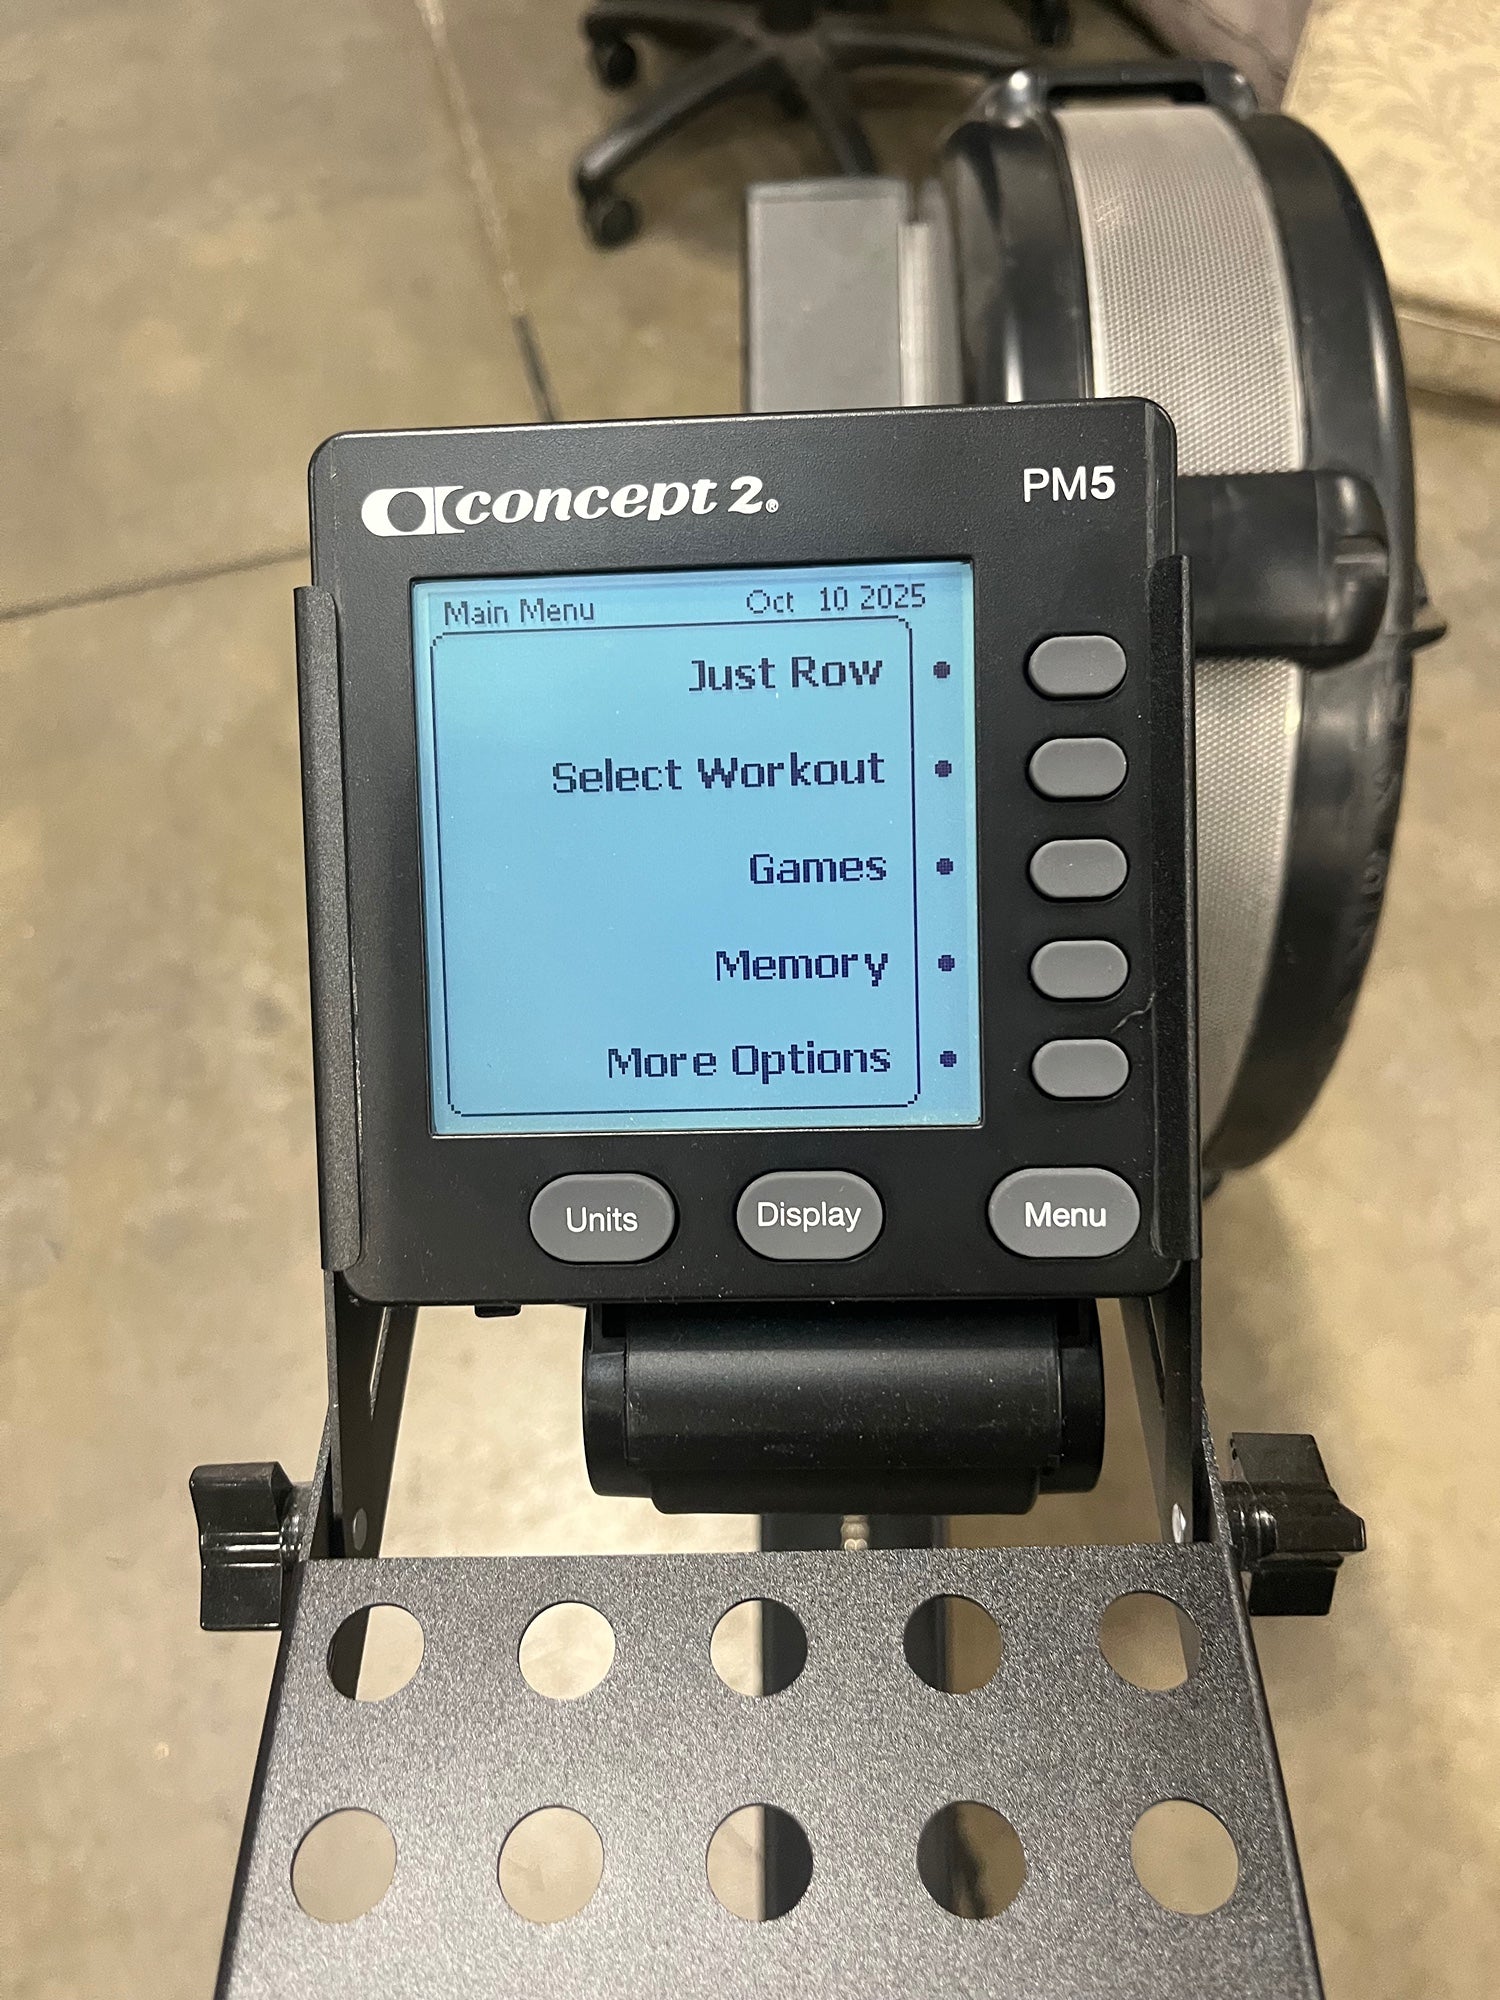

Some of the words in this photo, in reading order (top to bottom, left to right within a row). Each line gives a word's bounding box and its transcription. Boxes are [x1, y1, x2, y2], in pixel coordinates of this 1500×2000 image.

[456, 477, 718, 525] concept
[1023, 465, 1116, 503] PM5
[444, 600, 509, 627] Main
[519, 598, 595, 622] Menu
[746, 589, 795, 615] Oct
[820, 586, 849, 612] 10
[860, 583, 926, 611] 2025
[689, 657, 776, 692] Just
[791, 656, 884, 688] Row
[552, 758, 683, 793] Select
[697, 752, 885, 789] Workout
[749, 853, 887, 884] Games
[716, 950, 888, 987] Memory
[608, 1047, 717, 1078] More
[731, 1041, 891, 1084] Options
[565, 1205, 639, 1235] Units
[756, 1200, 863, 1233] Display
[1024, 1200, 1107, 1230] Menu
